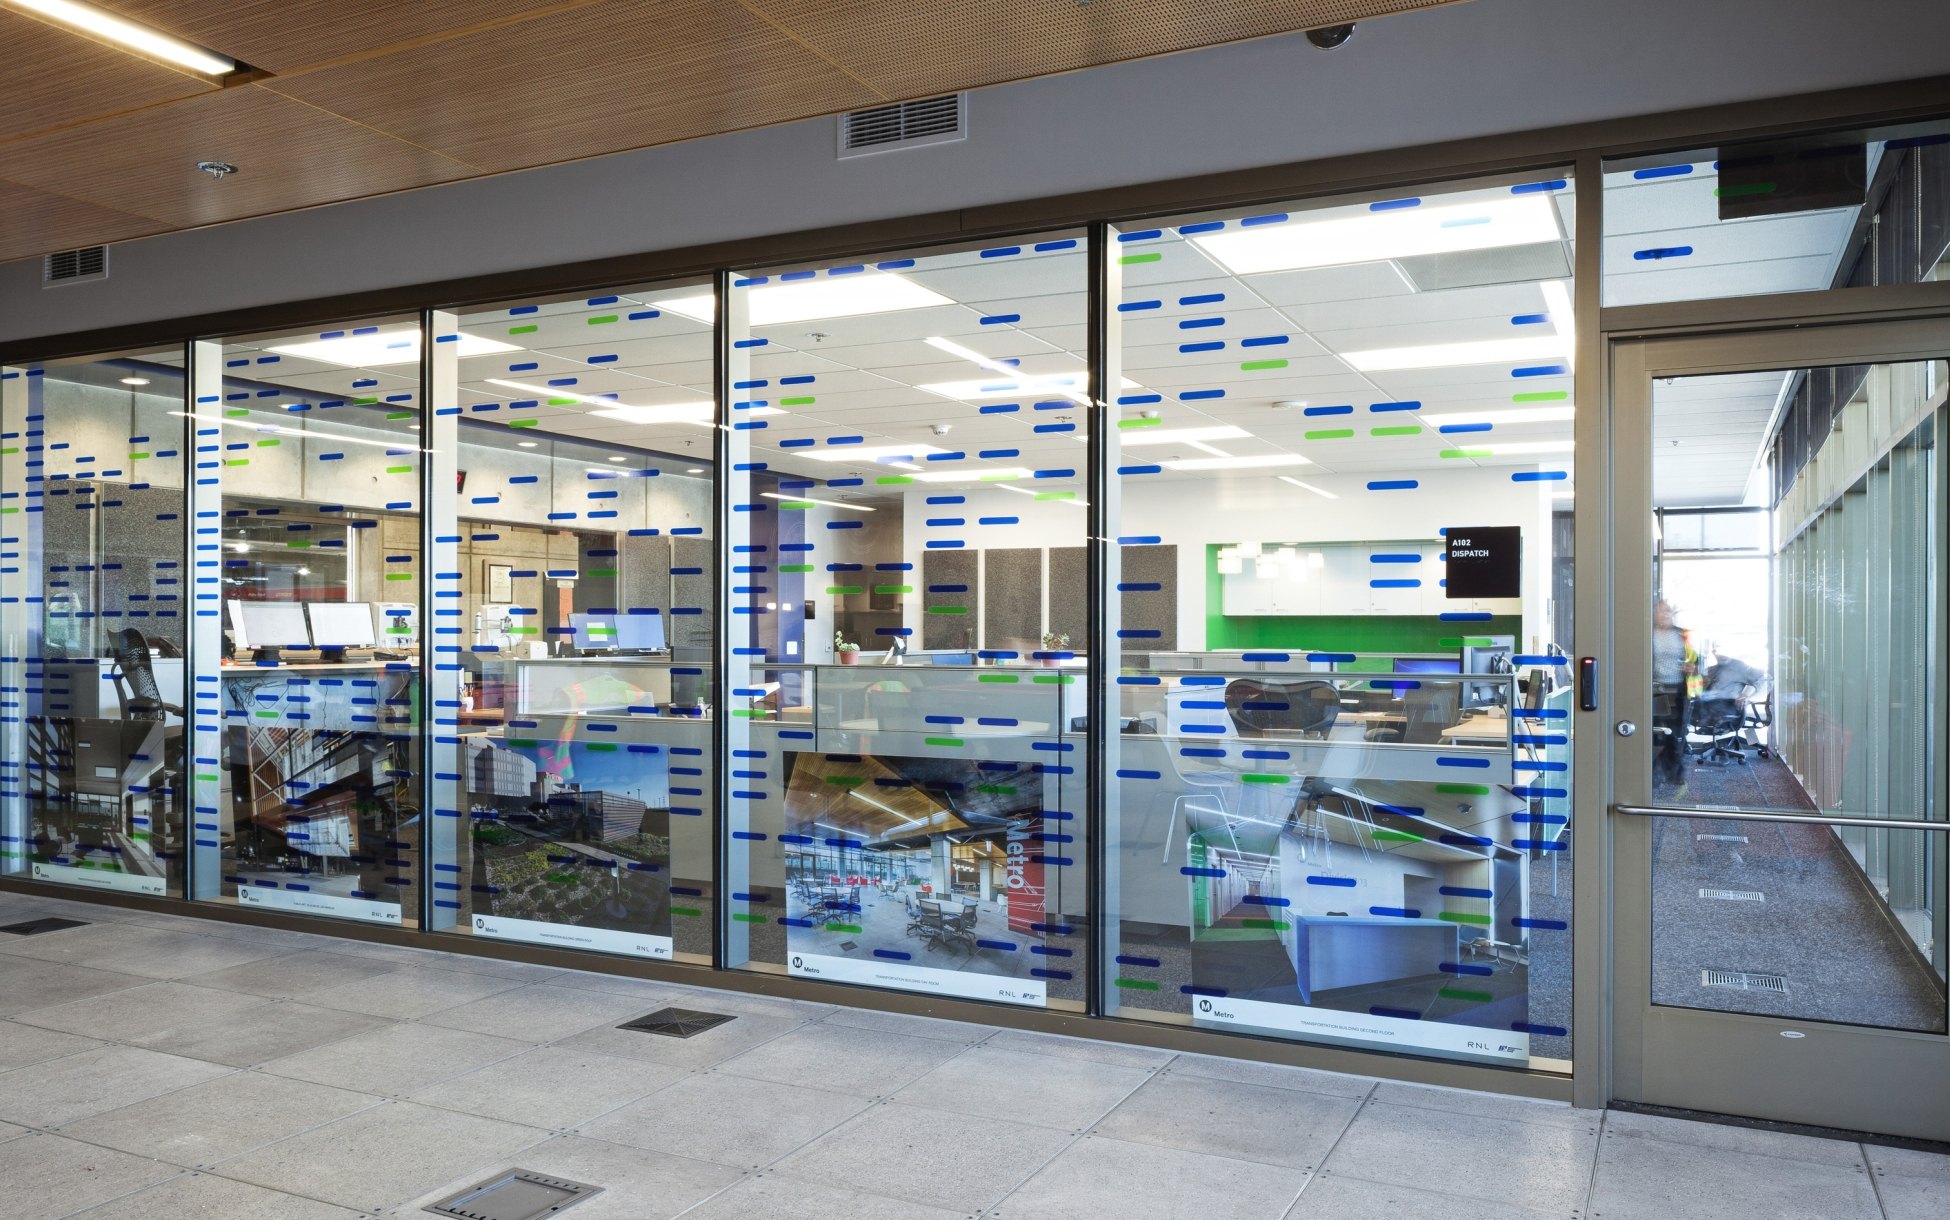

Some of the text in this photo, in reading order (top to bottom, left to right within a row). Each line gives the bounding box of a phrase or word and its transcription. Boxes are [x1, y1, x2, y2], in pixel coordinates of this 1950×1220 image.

[1006, 819, 1030, 889] Metro
[793, 957, 802, 968] M
[804, 966, 820, 974] Metro
[998, 989, 1016, 998] RNL
[1200, 1000, 1212, 1012] M
[1214, 1010, 1235, 1019] Metro
[1300, 1020, 1338, 1030] TRANSPORTATION
[1467, 1041, 1490, 1050] RNL
